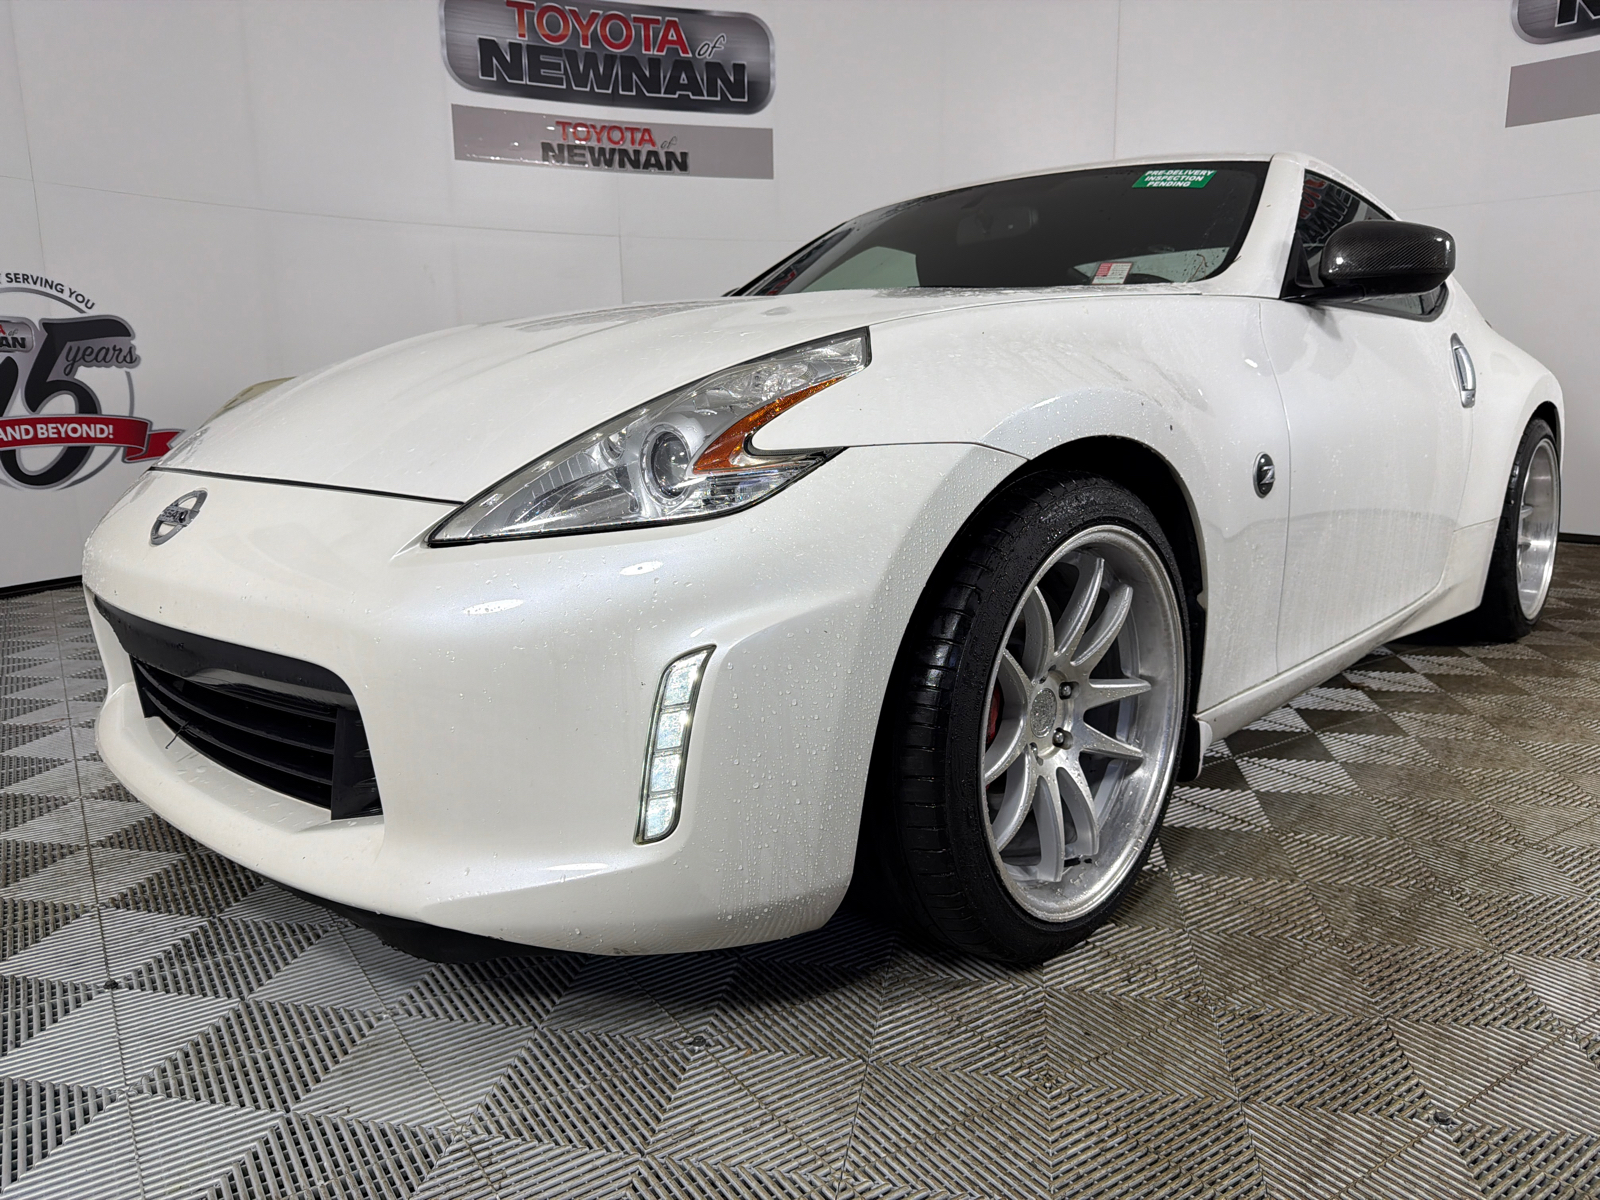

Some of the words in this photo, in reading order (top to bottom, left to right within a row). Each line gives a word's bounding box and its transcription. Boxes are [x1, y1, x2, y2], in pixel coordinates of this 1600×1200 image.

[506, 0, 692, 57] TOYOTA
[696, 34, 727, 59] of
[478, 36, 748, 102] NEWNAN
[555, 121, 657, 148] TOYOTA
[541, 141, 689, 173] NEWNAN
[5, 272, 65, 294] SERVING
[68, 288, 95, 310] YOU
[64, 345, 138, 376] years
[36, 423, 114, 439] BEYOND!
